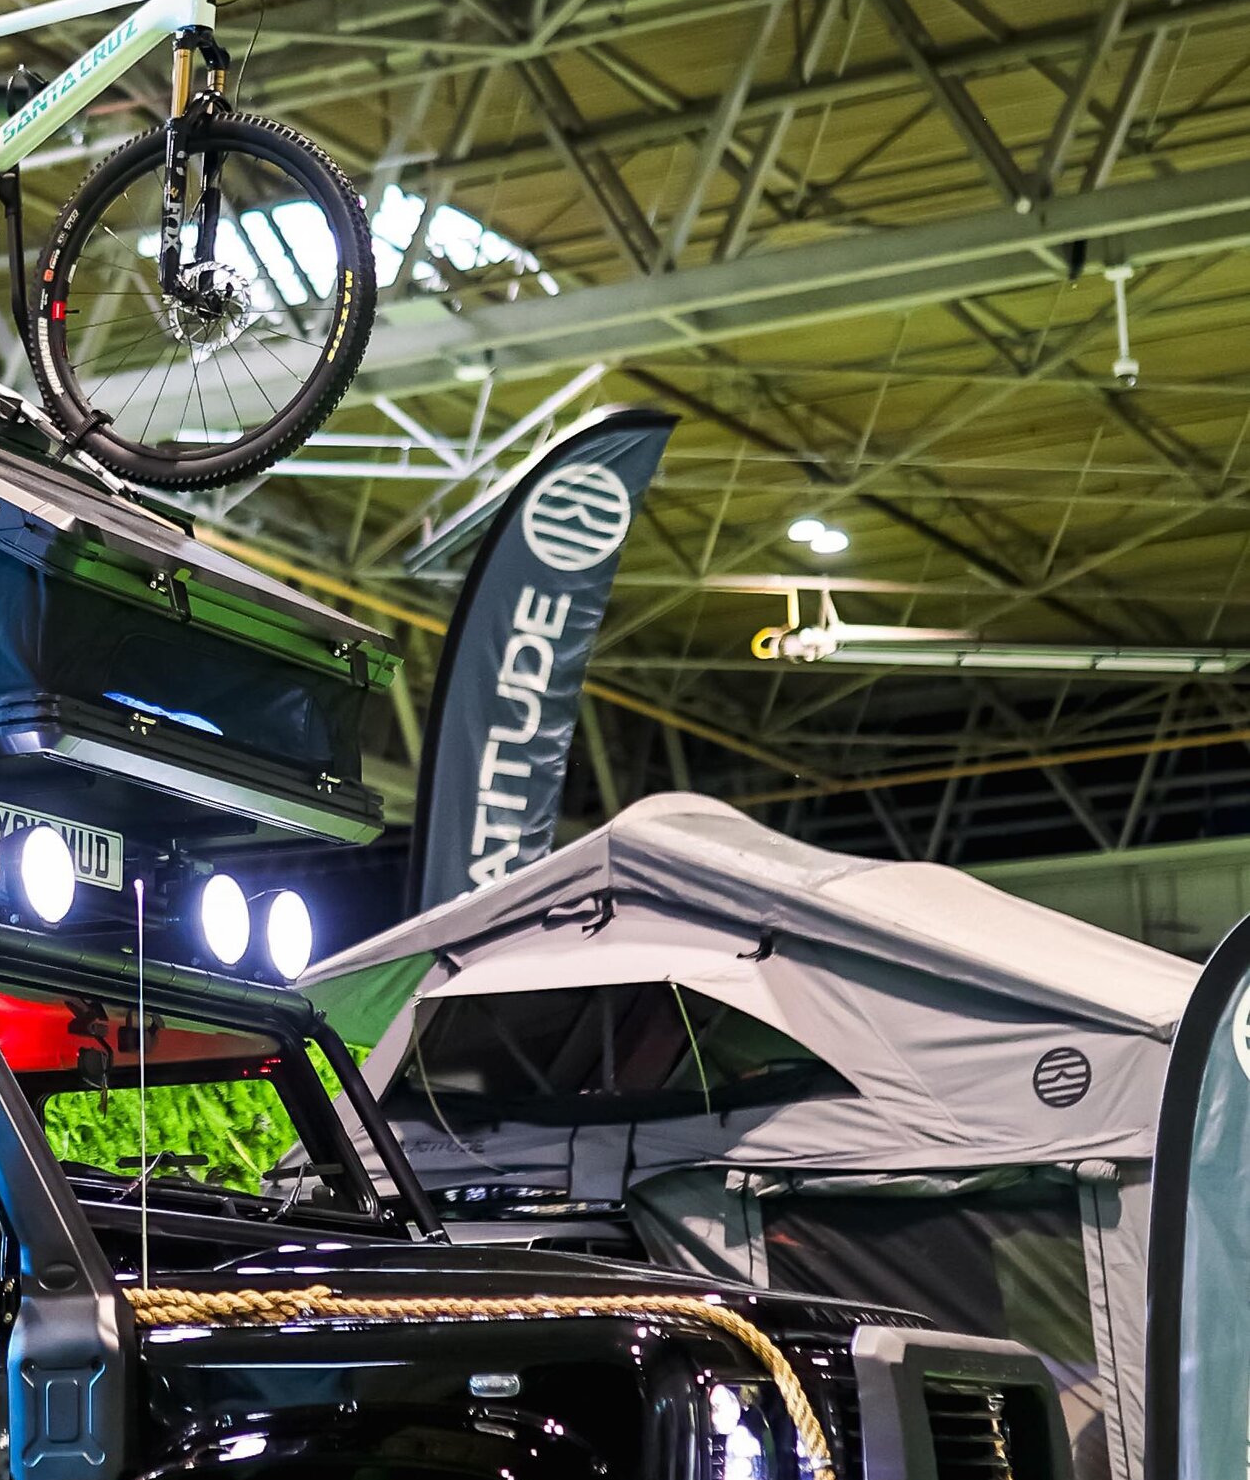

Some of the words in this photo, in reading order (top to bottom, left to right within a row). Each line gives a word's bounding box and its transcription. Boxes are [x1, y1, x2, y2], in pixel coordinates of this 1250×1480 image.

[3, 71, 77, 144] SANTA
[80, 19, 138, 77] CRUZ
[327, 269, 353, 364] MAXXIS
[458, 585, 572, 895] ATITUDE
